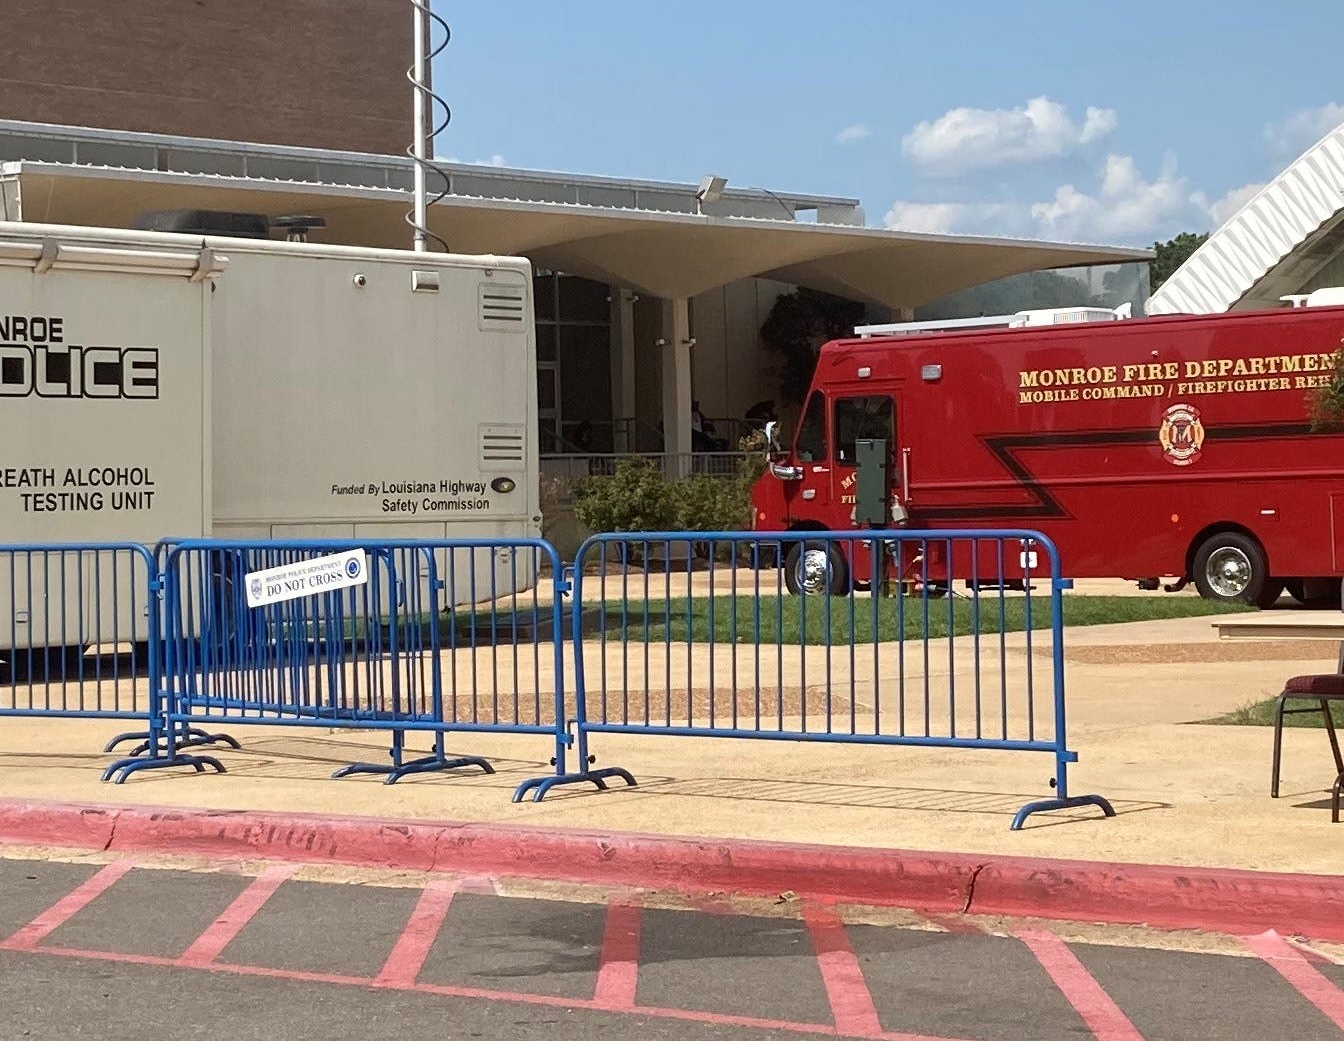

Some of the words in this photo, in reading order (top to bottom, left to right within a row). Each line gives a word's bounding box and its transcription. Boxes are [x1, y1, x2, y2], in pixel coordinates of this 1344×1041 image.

[1019, 366, 1117, 388] MONROE
[1123, 362, 1179, 382] FIRE
[1184, 352, 1338, 378] DEPARTMEN
[1019, 389, 1080, 404] MOBILE
[1082, 383, 1165, 400] COMMAND
[1167, 383, 1174, 398] /
[1177, 377, 1292, 395] FIREFIGHTER
[62, 467, 155, 487] ALCOHOL
[331, 484, 365, 495] Funded
[368, 484, 380, 496] By
[382, 480, 436, 494] Louisiana
[439, 479, 487, 496] Highway
[20, 492, 104, 512] TESTING
[111, 491, 155, 510] UNIT
[382, 498, 419, 514] Safety
[422, 497, 490, 511] Commission
[266, 583, 282, 597] DO
[284, 578, 305, 592] NOT
[308, 570, 343, 588] CROSS
